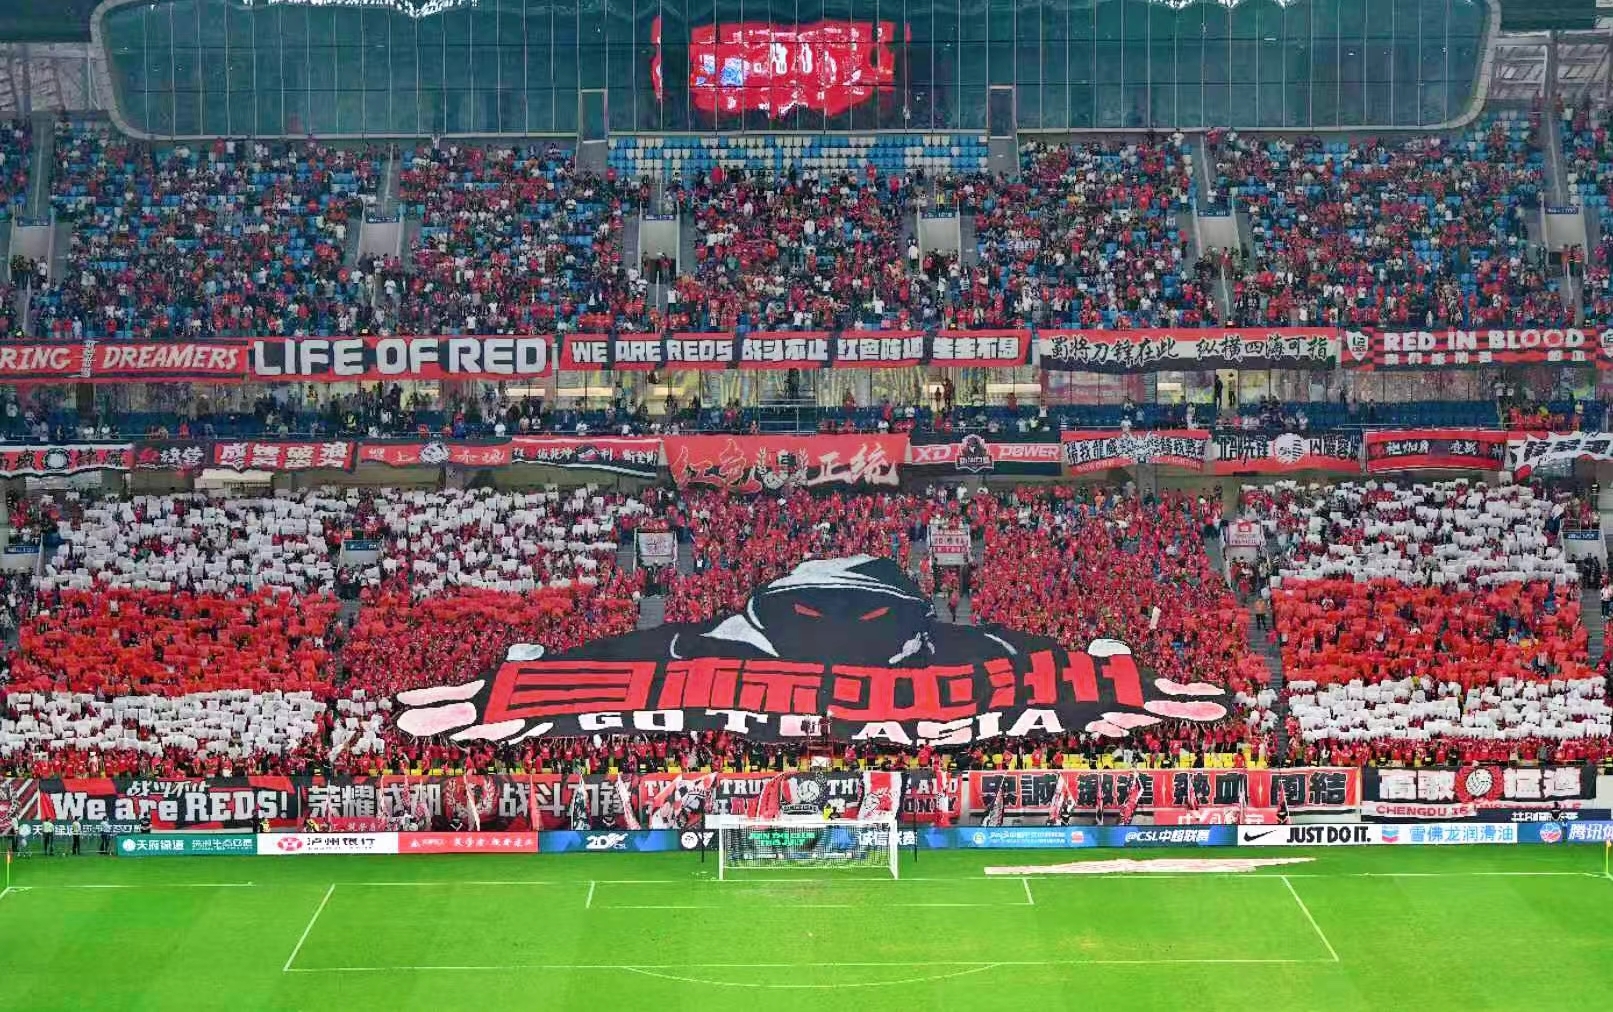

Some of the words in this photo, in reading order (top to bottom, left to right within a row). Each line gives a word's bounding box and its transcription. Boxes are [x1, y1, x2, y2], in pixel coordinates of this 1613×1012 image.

[571, 341, 608, 362] WE
[666, 339, 733, 361] REDS
[1384, 331, 1437, 350] RED
[1447, 331, 1477, 350] IN
[1488, 328, 1586, 350] BLOOD
[0, 345, 71, 370] RING
[102, 344, 239, 370] DREAMERS
[254, 338, 364, 375] LIFE
[376, 338, 439, 374] OF
[449, 338, 547, 373] RED
[484, 650, 1145, 724] 目标亚洲
[579, 709, 686, 732] GO
[852, 708, 1066, 746] ASIA
[51, 792, 107, 820] We
[115, 799, 178, 821] are
[185, 790, 288, 821] REDS!
[1375, 804, 1447, 816] CHENGDU
[1286, 826, 1326, 843] JUST
[1327, 826, 1352, 843] DO
[1354, 826, 1372, 843] IT.
